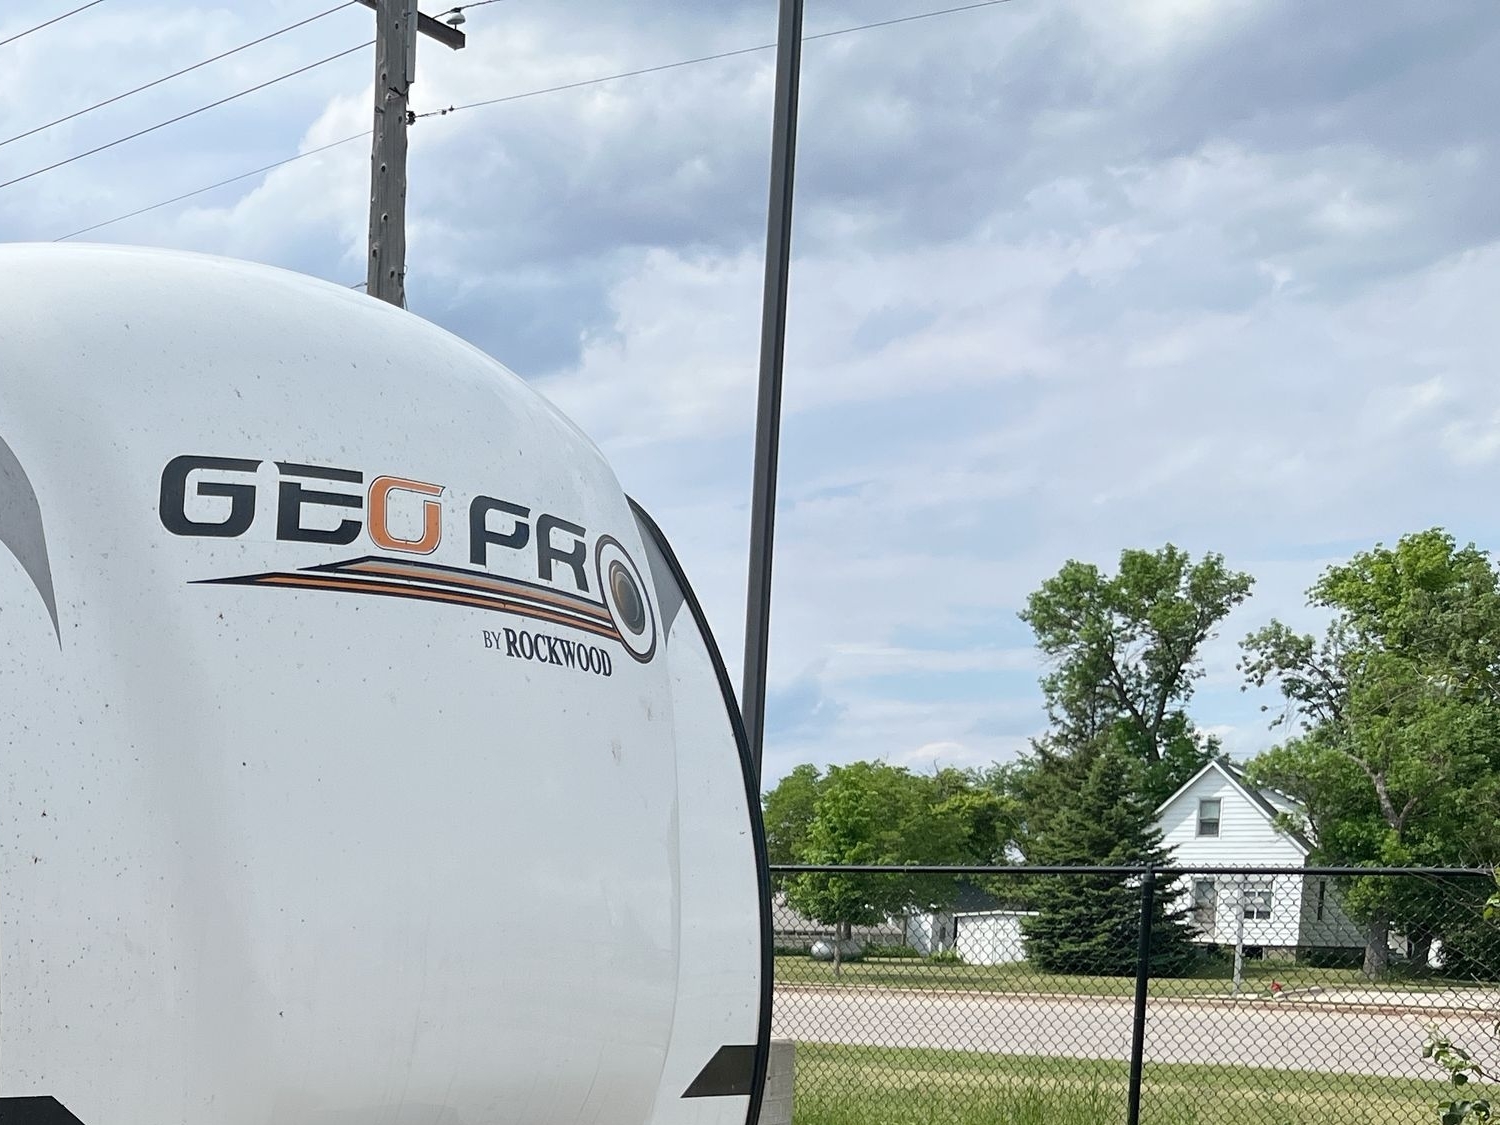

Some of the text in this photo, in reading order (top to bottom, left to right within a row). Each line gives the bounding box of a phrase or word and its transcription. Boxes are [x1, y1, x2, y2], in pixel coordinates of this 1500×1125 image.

[159, 454, 445, 555] GEO
[483, 627, 613, 677] BY ROCKWOOD
